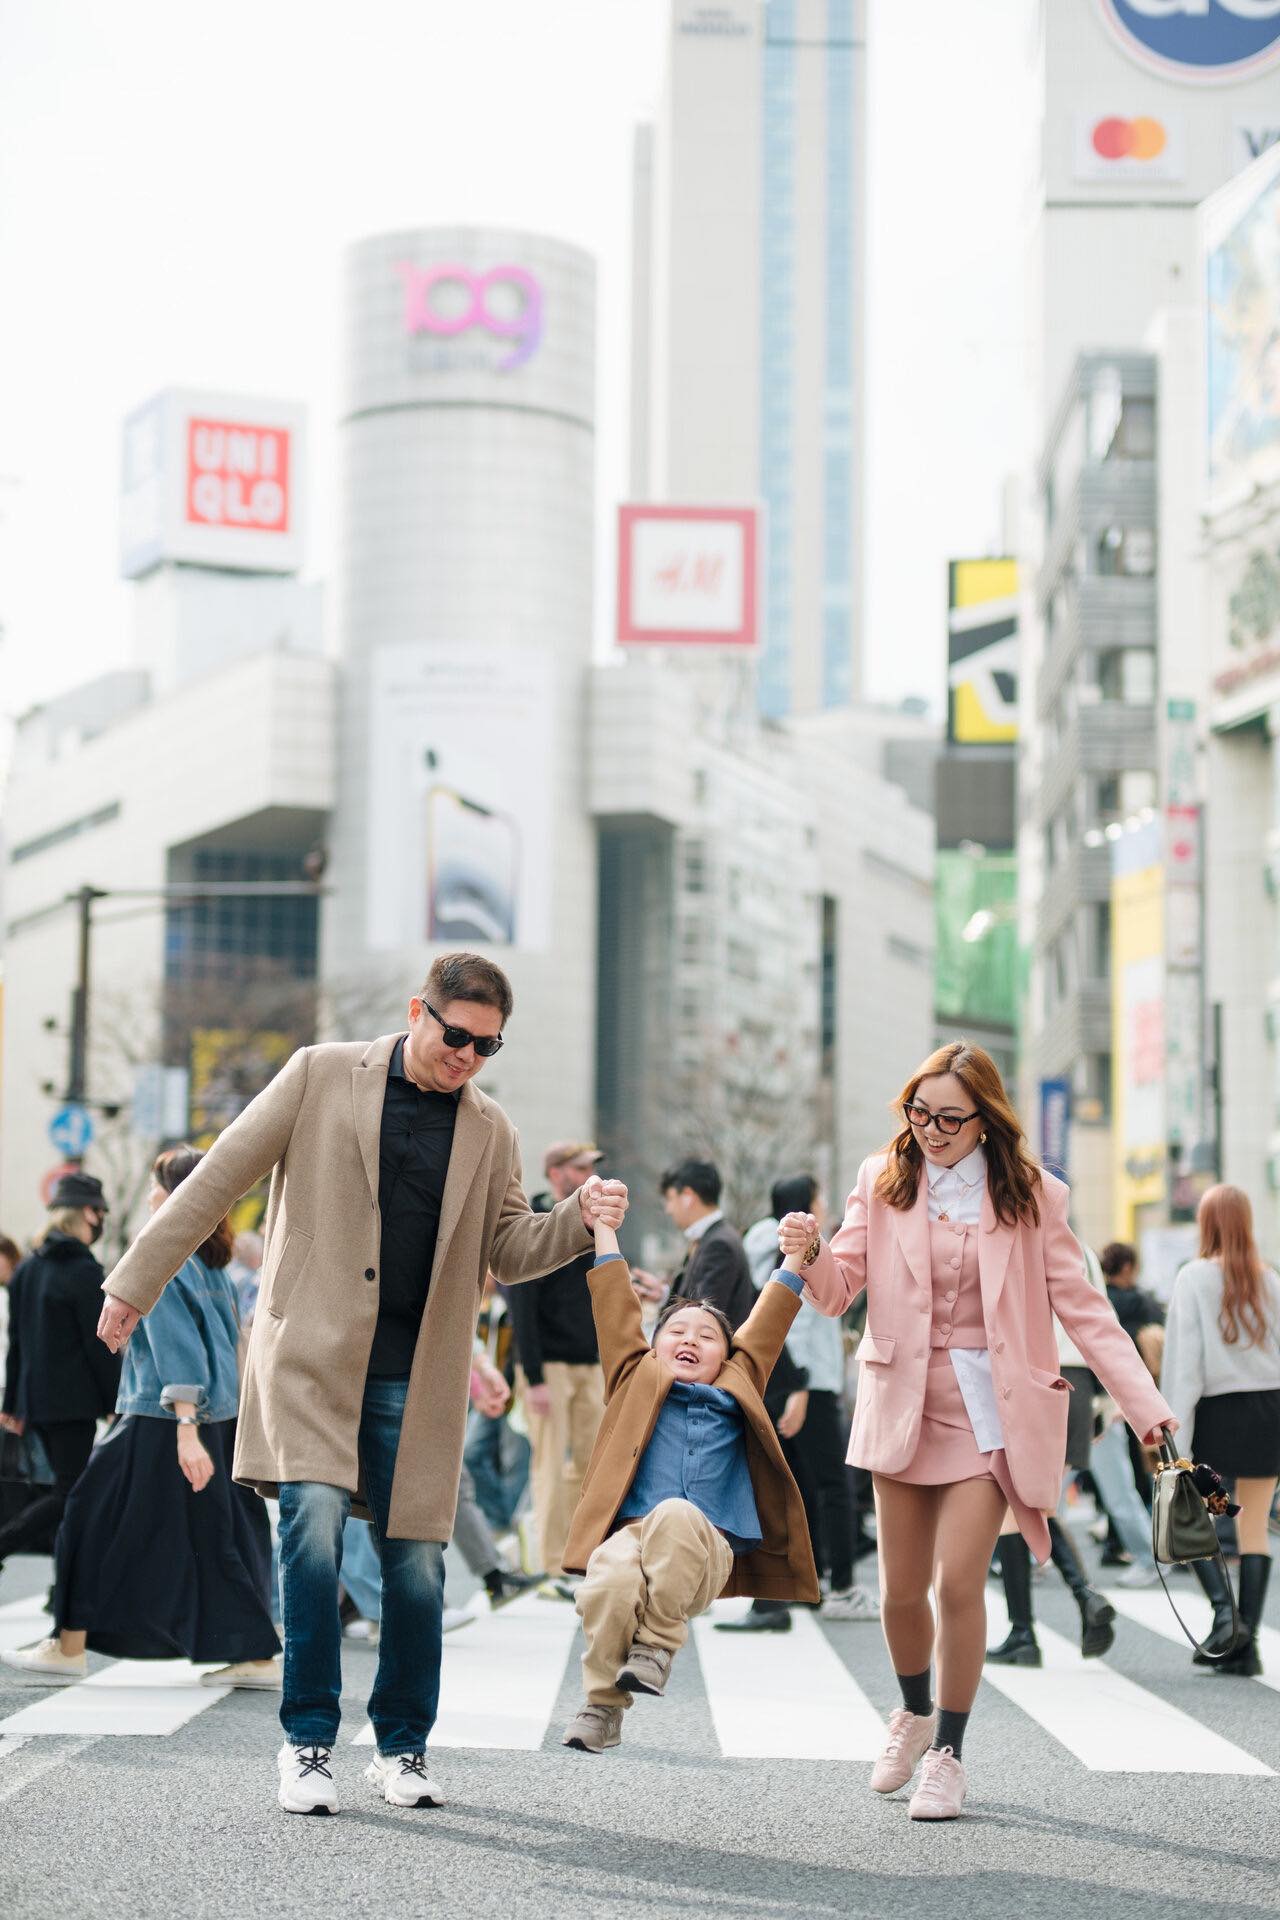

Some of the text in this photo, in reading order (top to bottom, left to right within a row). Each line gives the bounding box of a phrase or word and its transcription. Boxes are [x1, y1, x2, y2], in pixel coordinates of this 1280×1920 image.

[393, 261, 544, 368] 109
[193, 426, 277, 477] UNI
[192, 474, 285, 525] QLO
